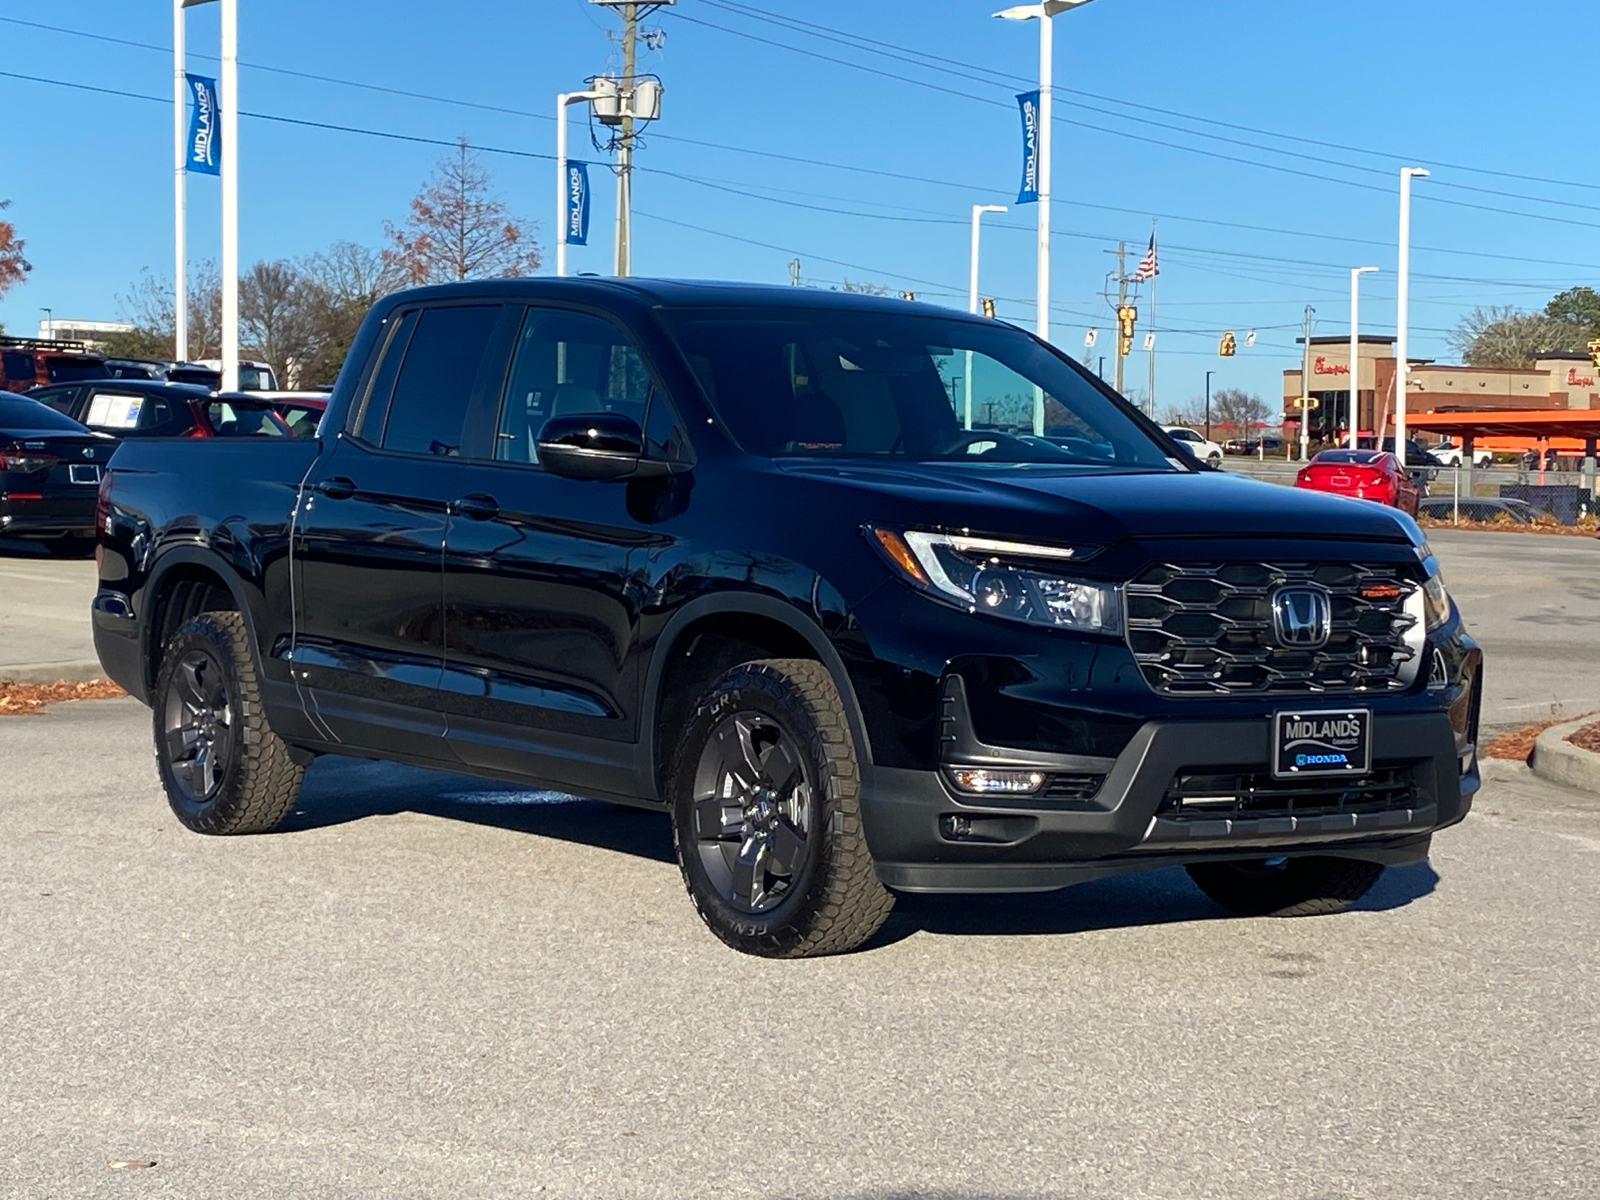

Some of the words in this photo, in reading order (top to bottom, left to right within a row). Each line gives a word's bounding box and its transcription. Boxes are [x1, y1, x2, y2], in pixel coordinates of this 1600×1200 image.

[193, 82, 209, 162] MIDLANDS
[1024, 101, 1035, 191] MIDLANDS
[570, 167, 580, 236] MIDLANDS
[1285, 719, 1361, 739] MIDLANDS
[1306, 754, 1348, 764] HONDA
